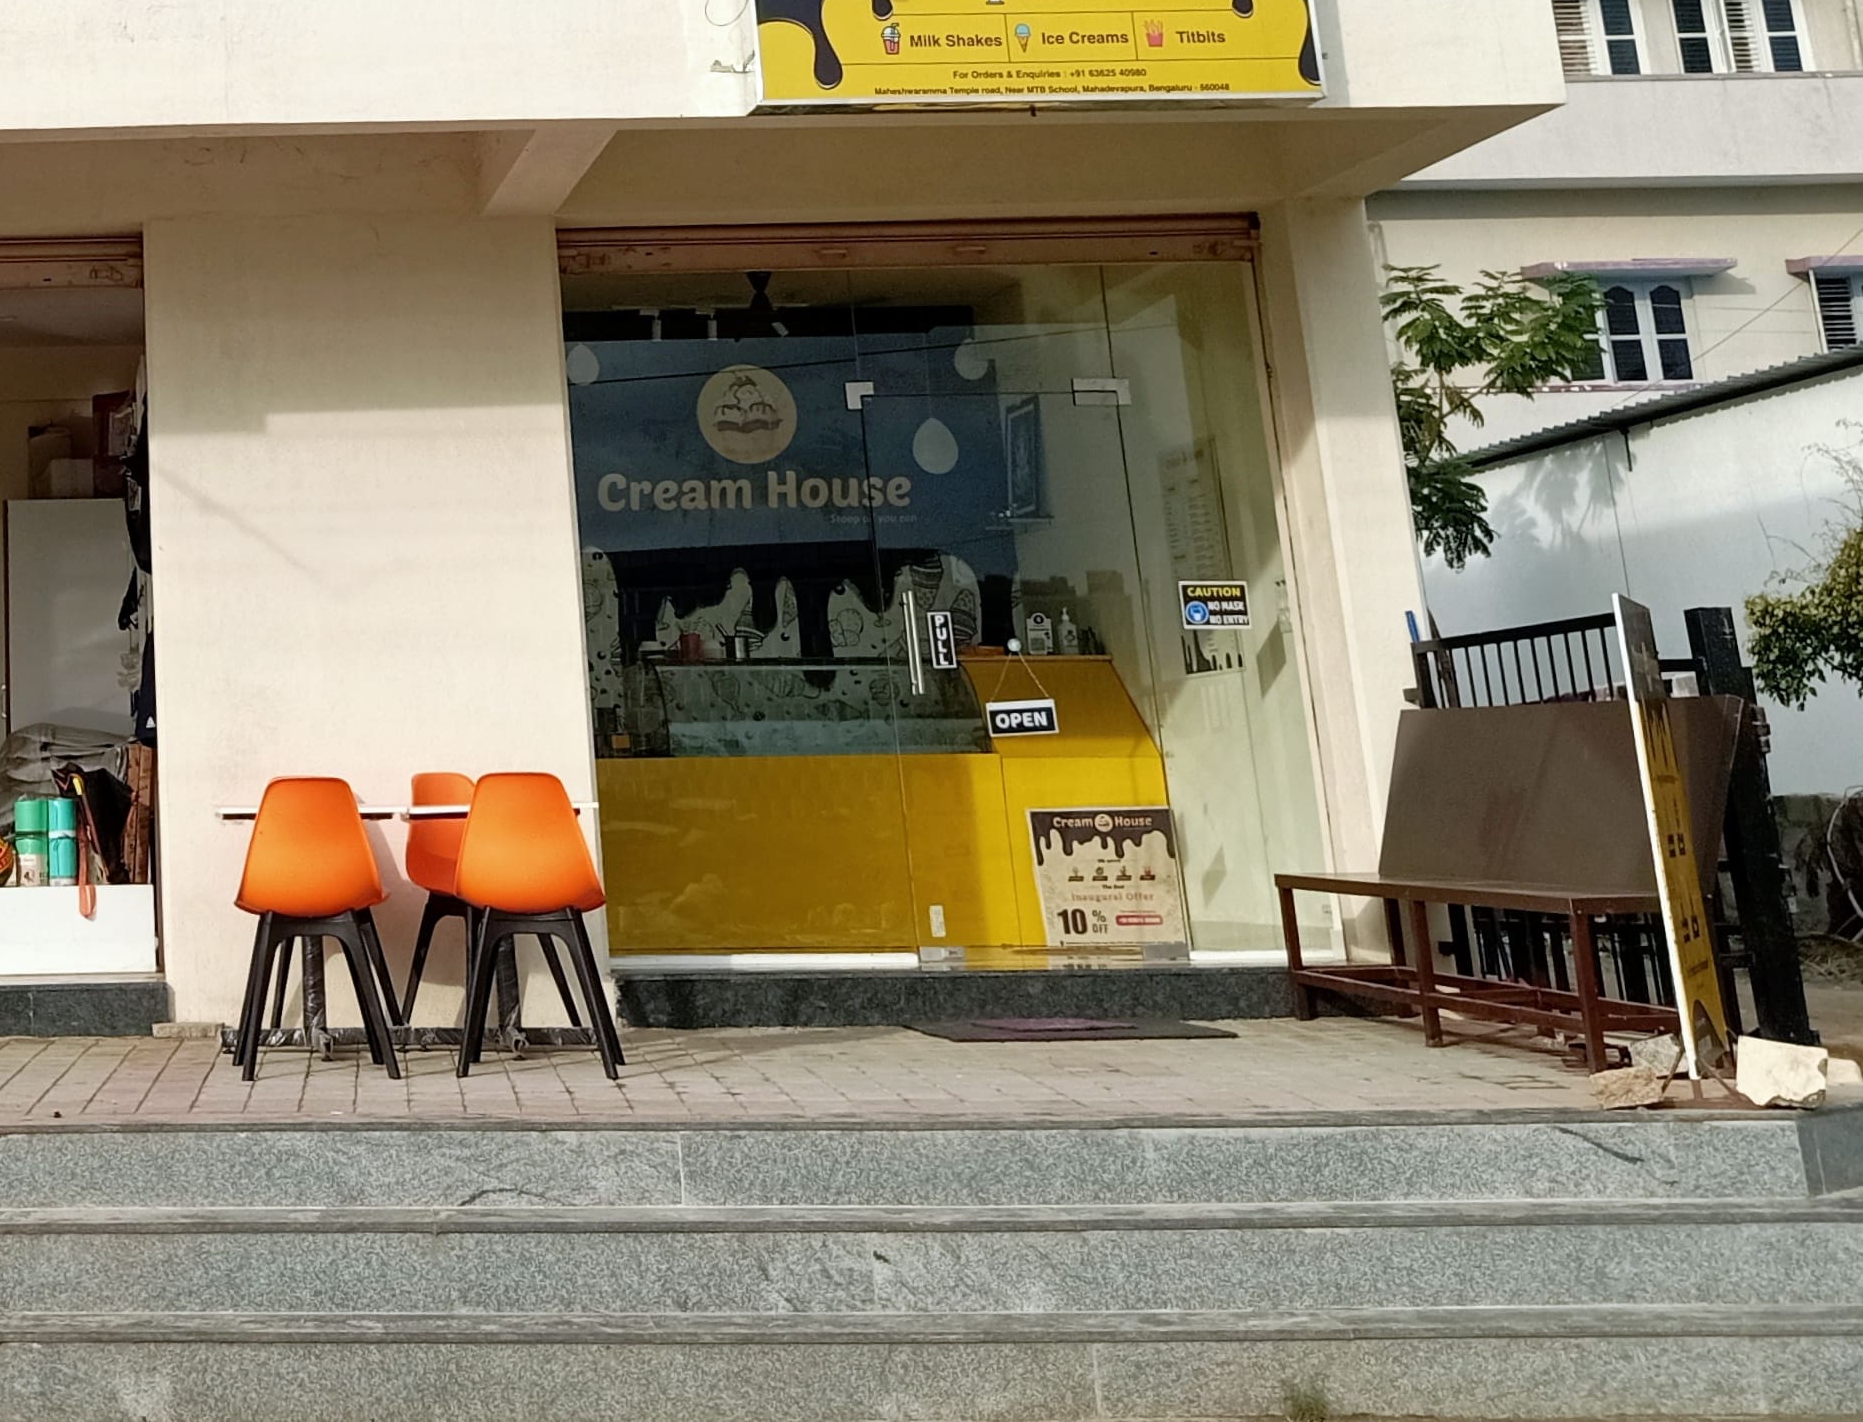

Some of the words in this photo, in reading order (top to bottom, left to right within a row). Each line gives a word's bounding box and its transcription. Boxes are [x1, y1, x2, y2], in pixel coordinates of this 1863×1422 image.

[909, 33, 941, 47] Milk
[946, 33, 1003, 47] Shakes
[1041, 31, 1064, 45] Ice
[1069, 30, 1129, 44] Creams
[1176, 30, 1226, 44] Titbits
[953, 70, 969, 79] For
[971, 70, 1003, 79] Orders
[1006, 70, 1013, 79] &
[1016, 69, 1061, 81] Enquiries
[949, 86, 979, 95] Temple
[981, 86, 1003, 95] road,
[1005, 86, 1025, 94] Near
[1048, 85, 1080, 94] School,
[1149, 83, 1192, 94] Bengaluru
[597, 473, 753, 512] Cream
[766, 470, 913, 510] House
[1186, 586, 1241, 598] CAUTION
[1207, 600, 1220, 611] NO
[1221, 600, 1245, 611] MASK
[1209, 614, 1222, 625] NO
[1223, 614, 1249, 625] ENTRY
[934, 614, 949, 666] PULL
[995, 711, 1048, 729] OPEN
[1053, 816, 1094, 828] Cream
[1114, 816, 1153, 827] House
[1071, 892, 1123, 903] Inaugural
[1126, 892, 1155, 901] Offer
[1057, 908, 1088, 935] 10
[1092, 923, 1109, 934] OFF
